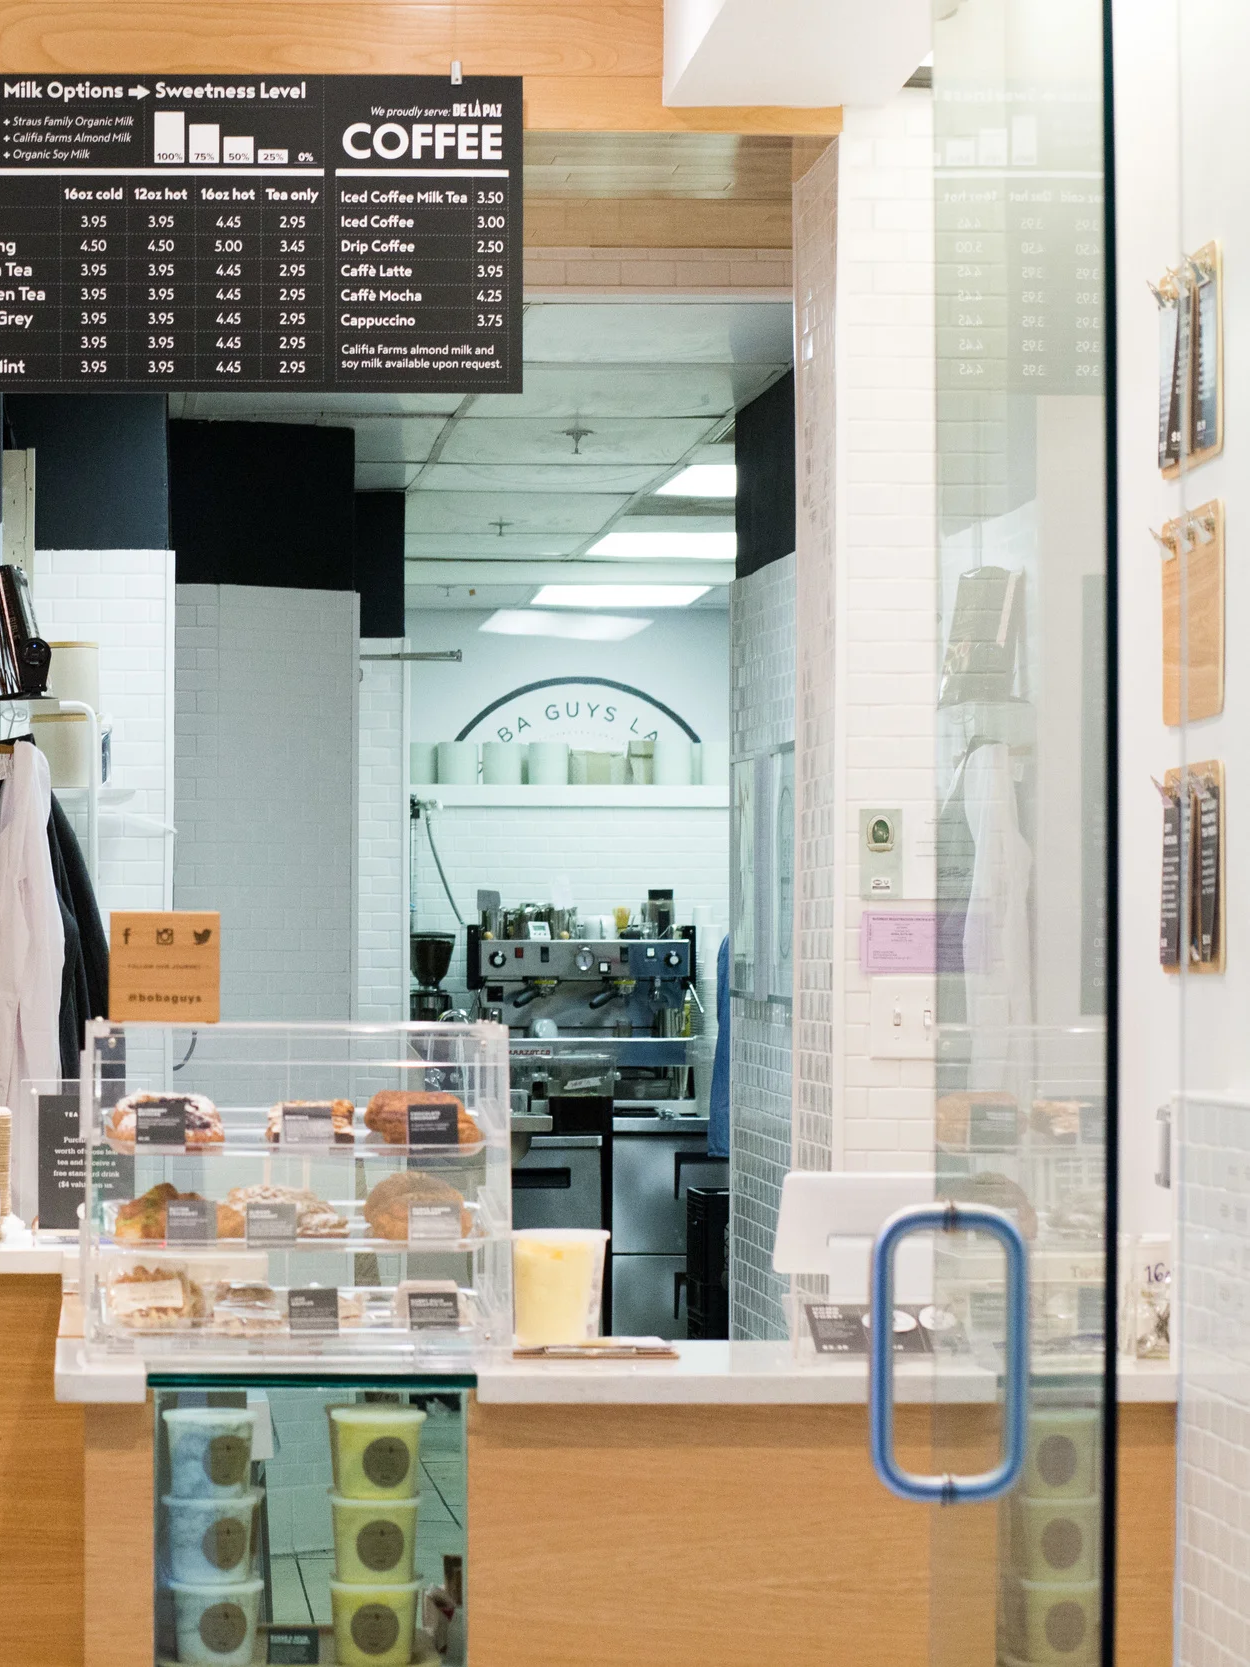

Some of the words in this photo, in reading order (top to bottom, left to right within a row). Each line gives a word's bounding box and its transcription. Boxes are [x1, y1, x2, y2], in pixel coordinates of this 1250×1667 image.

[4, 81, 42, 98] Milk
[47, 82, 123, 103] Options
[156, 82, 256, 99] Sweetness
[260, 82, 306, 99] Level
[371, 106, 385, 116] We
[386, 106, 423, 118] proudly
[424, 109, 451, 117] serve:
[453, 104, 467, 117] DE
[483, 104, 502, 117] PAZ
[13, 116, 41, 126] Straus
[44, 116, 73, 128] Family
[75, 117, 113, 128] Organic
[115, 116, 134, 126] Milk
[342, 123, 502, 160] COFFEE
[13, 150, 51, 161] Organic
[53, 150, 69, 161] Soy
[71, 149, 90, 159] Milk
[298, 152, 314, 162] 0%
[266, 188, 288, 201] Tea
[290, 188, 319, 204] only
[341, 190, 368, 203] Iced
[371, 190, 414, 203] Coffee
[417, 191, 444, 203] Milk
[445, 191, 468, 204] Tea
[477, 192, 504, 204] 3.50
[80, 240, 107, 252] 4.50
[148, 240, 174, 252] 4.50
[215, 240, 243, 252] 5.00
[280, 240, 305, 252] 3.45
[341, 288, 377, 301] Caffè
[380, 289, 422, 302] Mocha
[477, 290, 502, 302] 4.25
[341, 314, 416, 329] Cappuccino
[477, 314, 503, 327] 3.75
[342, 361, 359, 370] soy
[362, 358, 382, 368] milk
[385, 358, 430, 368] available
[432, 361, 459, 370] upon
[462, 360, 502, 371] request.
[545, 702, 617, 722] GUYS
[54, 1147, 76, 1155] worth
[101, 1170, 120, 1178] drink
